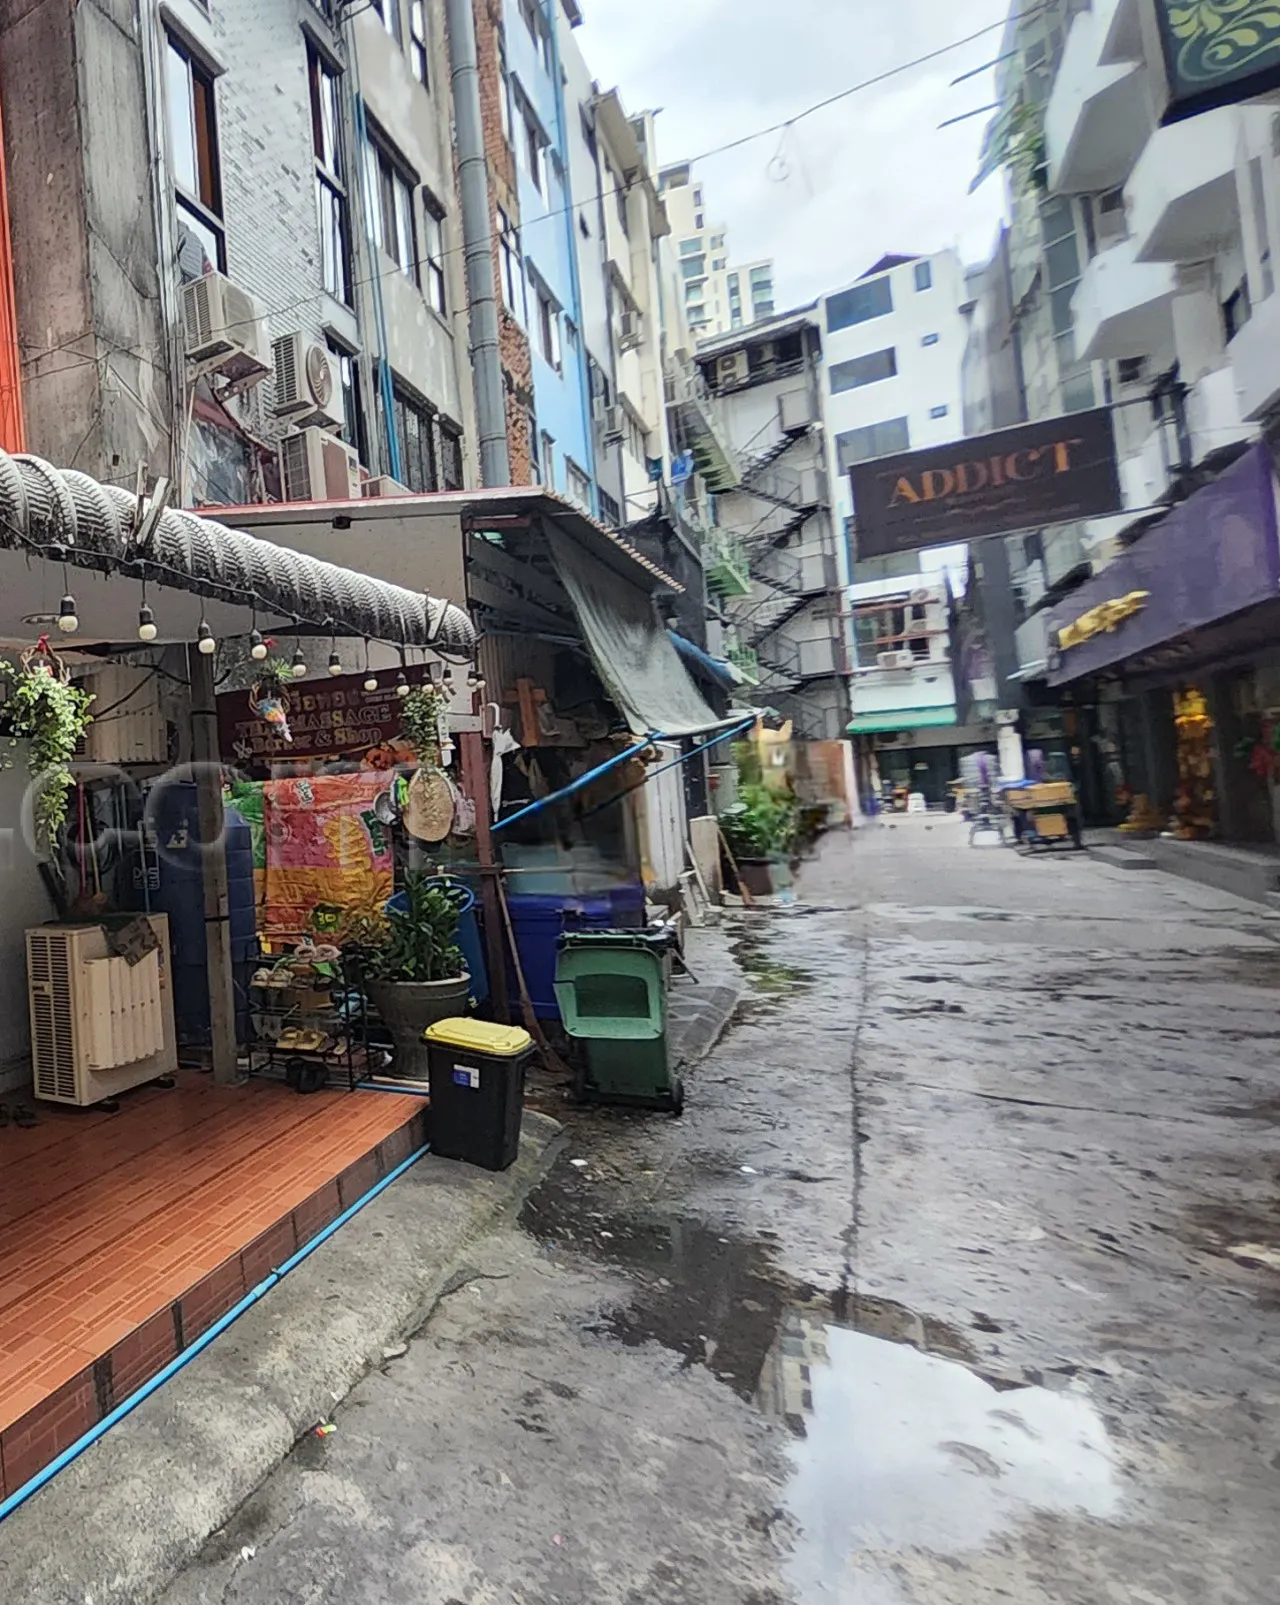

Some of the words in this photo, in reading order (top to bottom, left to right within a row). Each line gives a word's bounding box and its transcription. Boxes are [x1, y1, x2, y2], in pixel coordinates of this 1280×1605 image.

[887, 438, 1084, 509] ADDICT
[287, 703, 392, 732] MASSAGE
[314, 730, 333, 748] &
[334, 726, 382, 746] Shop
